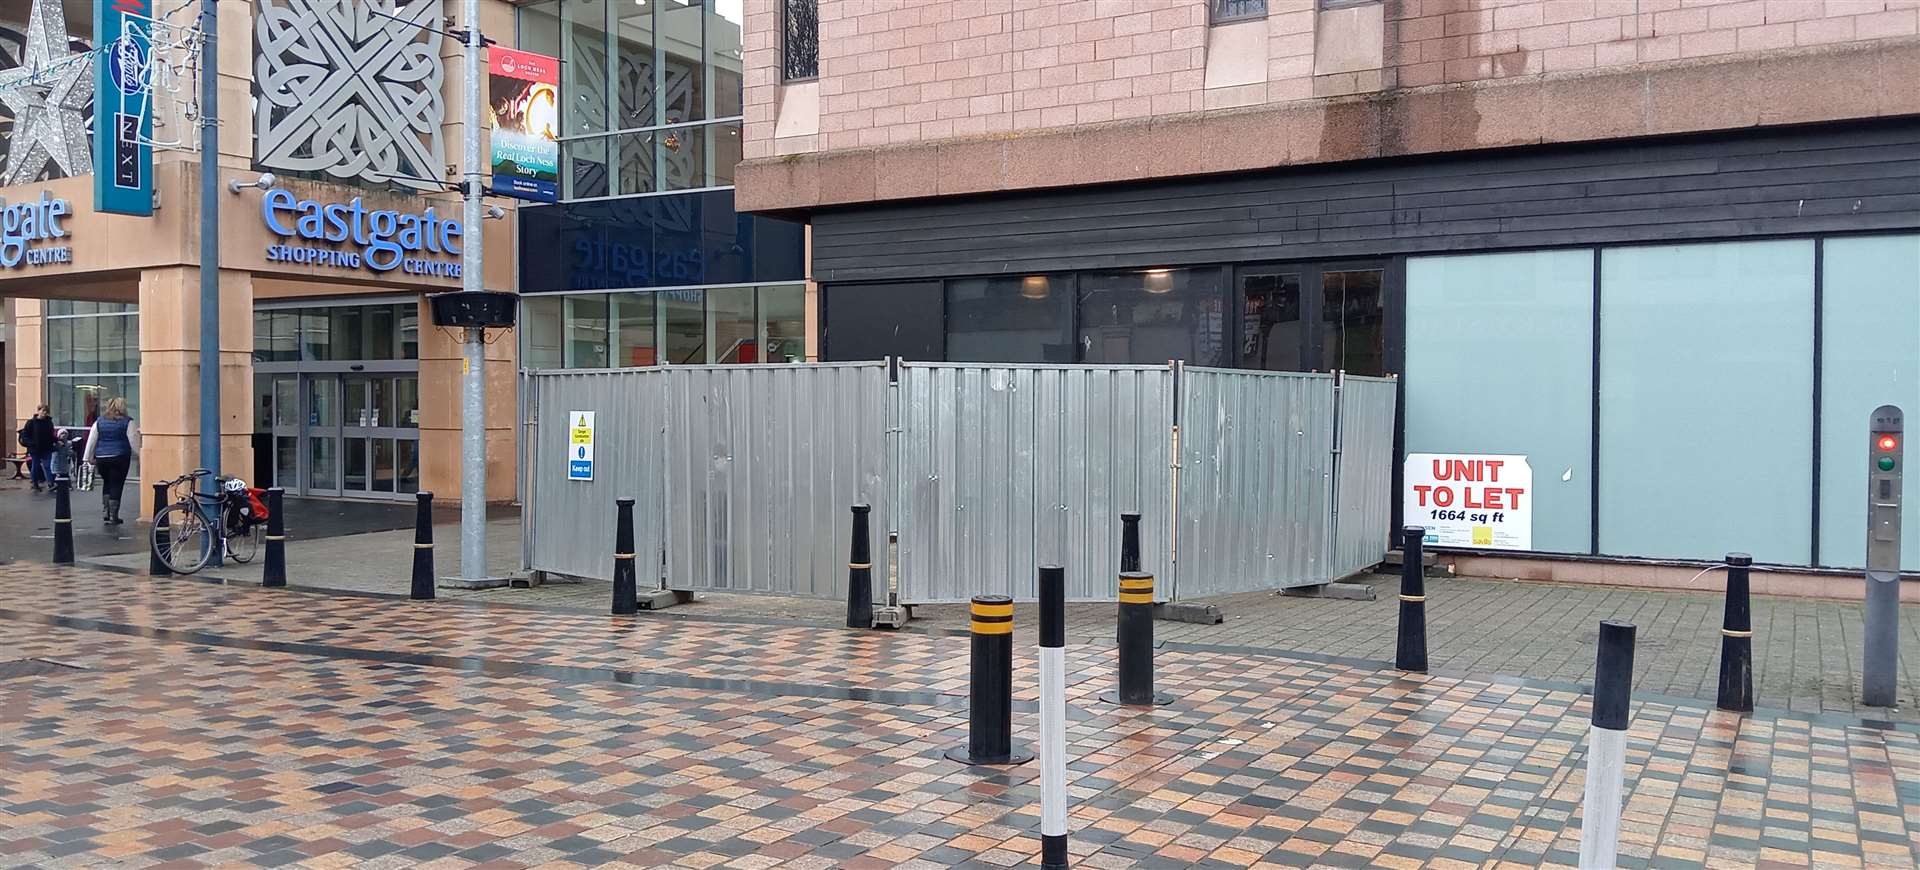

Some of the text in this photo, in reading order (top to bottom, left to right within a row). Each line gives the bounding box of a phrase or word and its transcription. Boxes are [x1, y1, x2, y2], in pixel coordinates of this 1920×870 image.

[121, 121, 133, 184] NEXT
[500, 139, 550, 154] Discover the
[496, 151, 554, 167] Real Loch Ness
[516, 164, 537, 177] Story
[262, 188, 463, 271] eastgate
[25, 246, 70, 265] CENTRE
[267, 243, 360, 268] SHOPPING
[403, 258, 463, 279] CENTRE
[571, 465, 583, 473] Keep
[1433, 459, 1504, 482] UNIT
[1414, 485, 1525, 510] TO LET
[1430, 509, 1505, 524] 1664 sq ft
